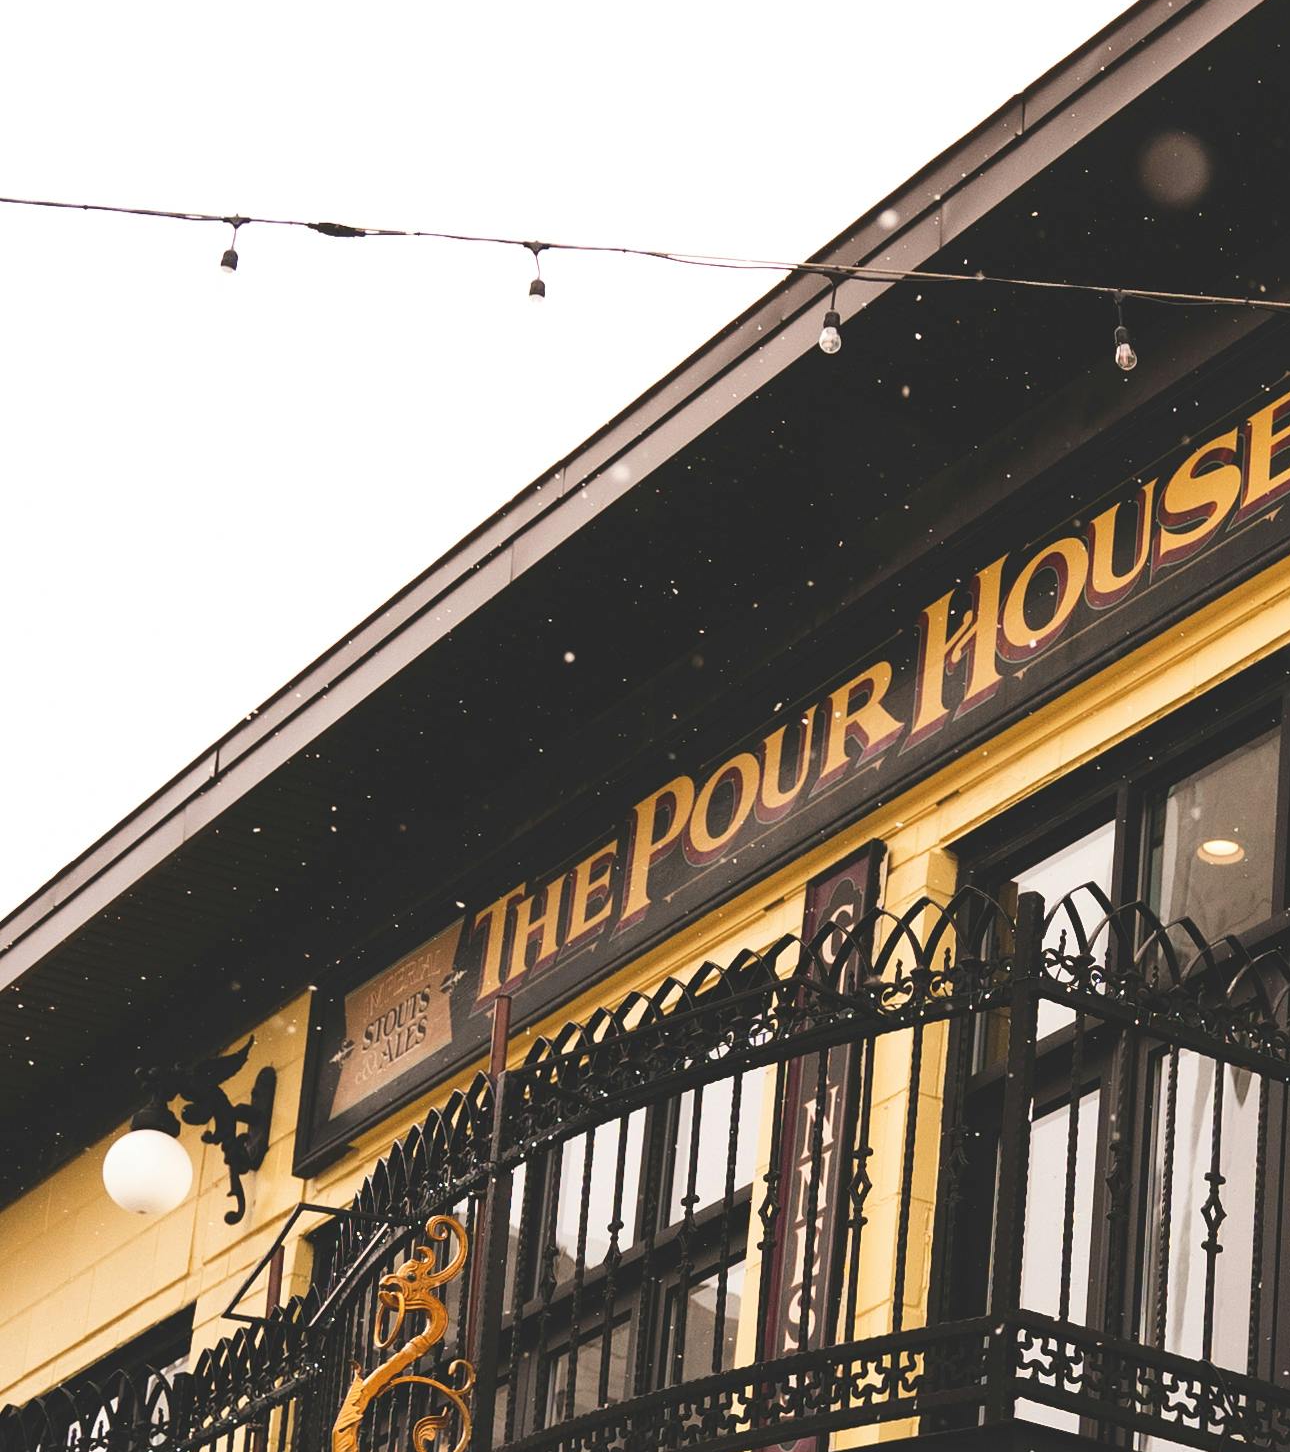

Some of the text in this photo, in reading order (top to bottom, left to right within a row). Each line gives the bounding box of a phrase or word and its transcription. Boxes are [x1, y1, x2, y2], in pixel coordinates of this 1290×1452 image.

[473, 842, 613, 1003] THE
[620, 660, 903, 924] POUR
[363, 985, 430, 1051] STOUTS
[379, 1015, 428, 1070] ALES
